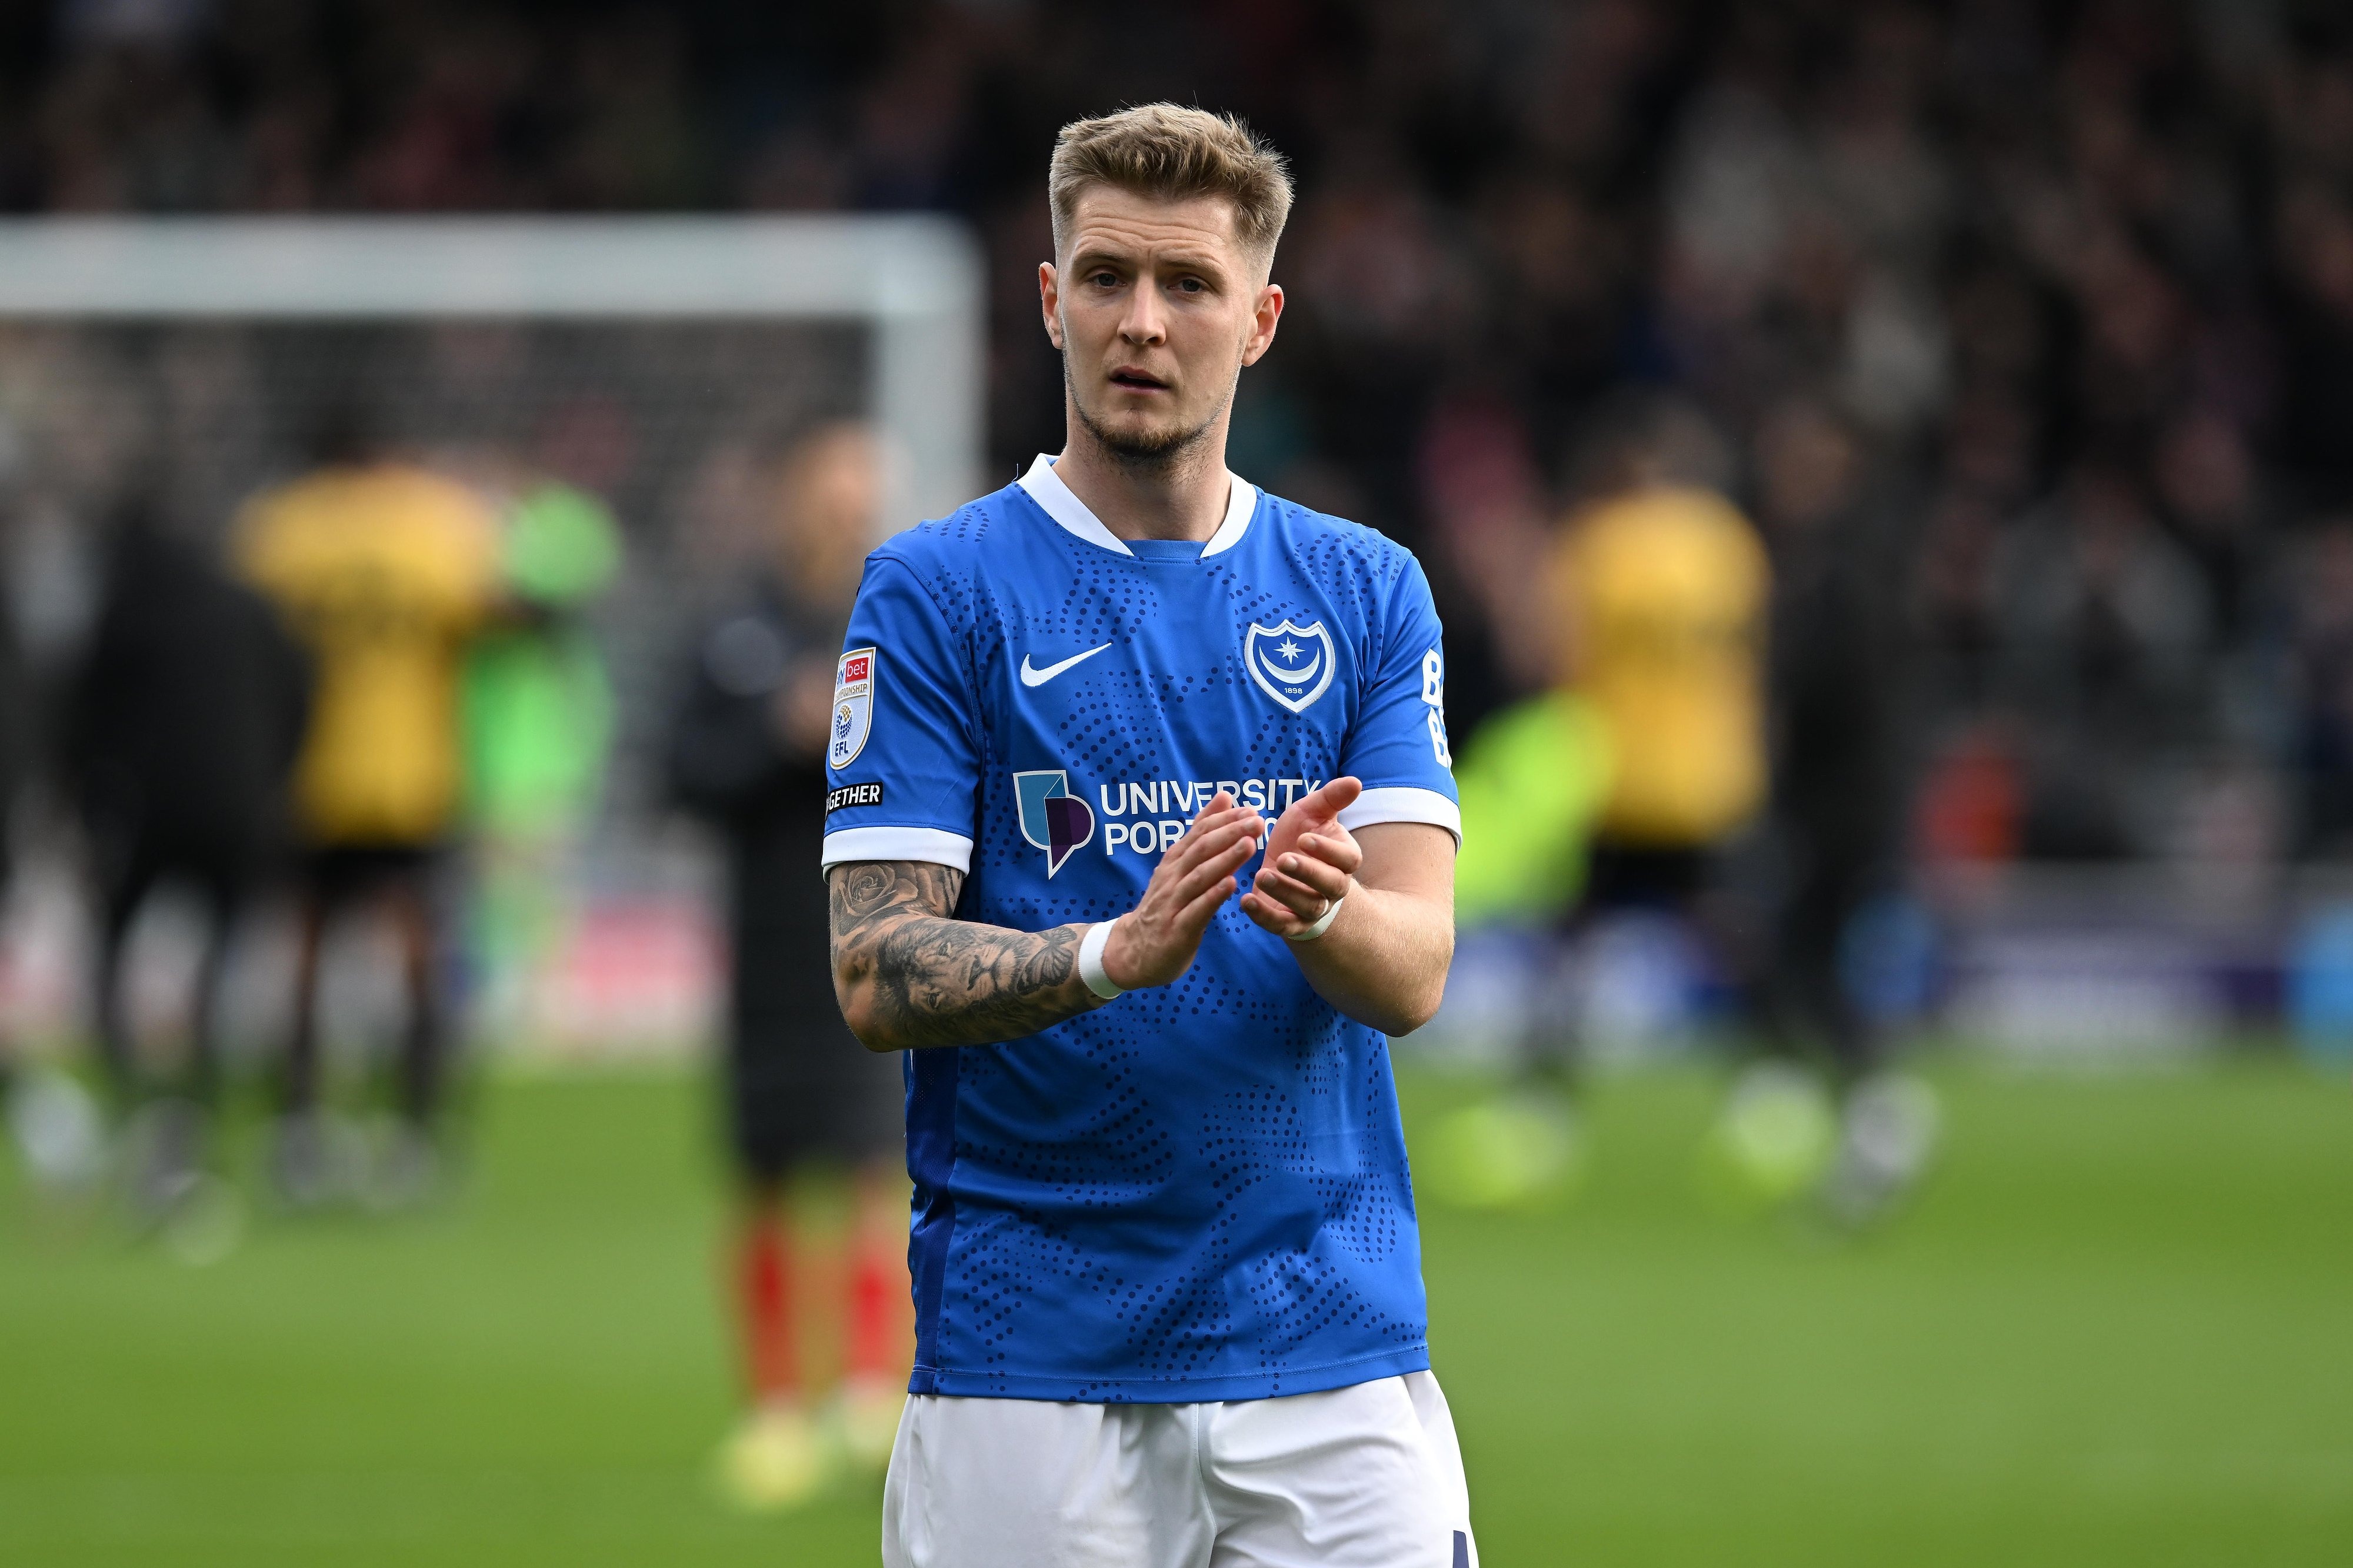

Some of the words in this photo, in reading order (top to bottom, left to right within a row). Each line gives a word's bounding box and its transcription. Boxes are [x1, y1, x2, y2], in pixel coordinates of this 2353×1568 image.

[847, 661, 866, 677] bet
[835, 740, 848, 757] EFL
[1101, 779, 1321, 816] UNIVERSITY
